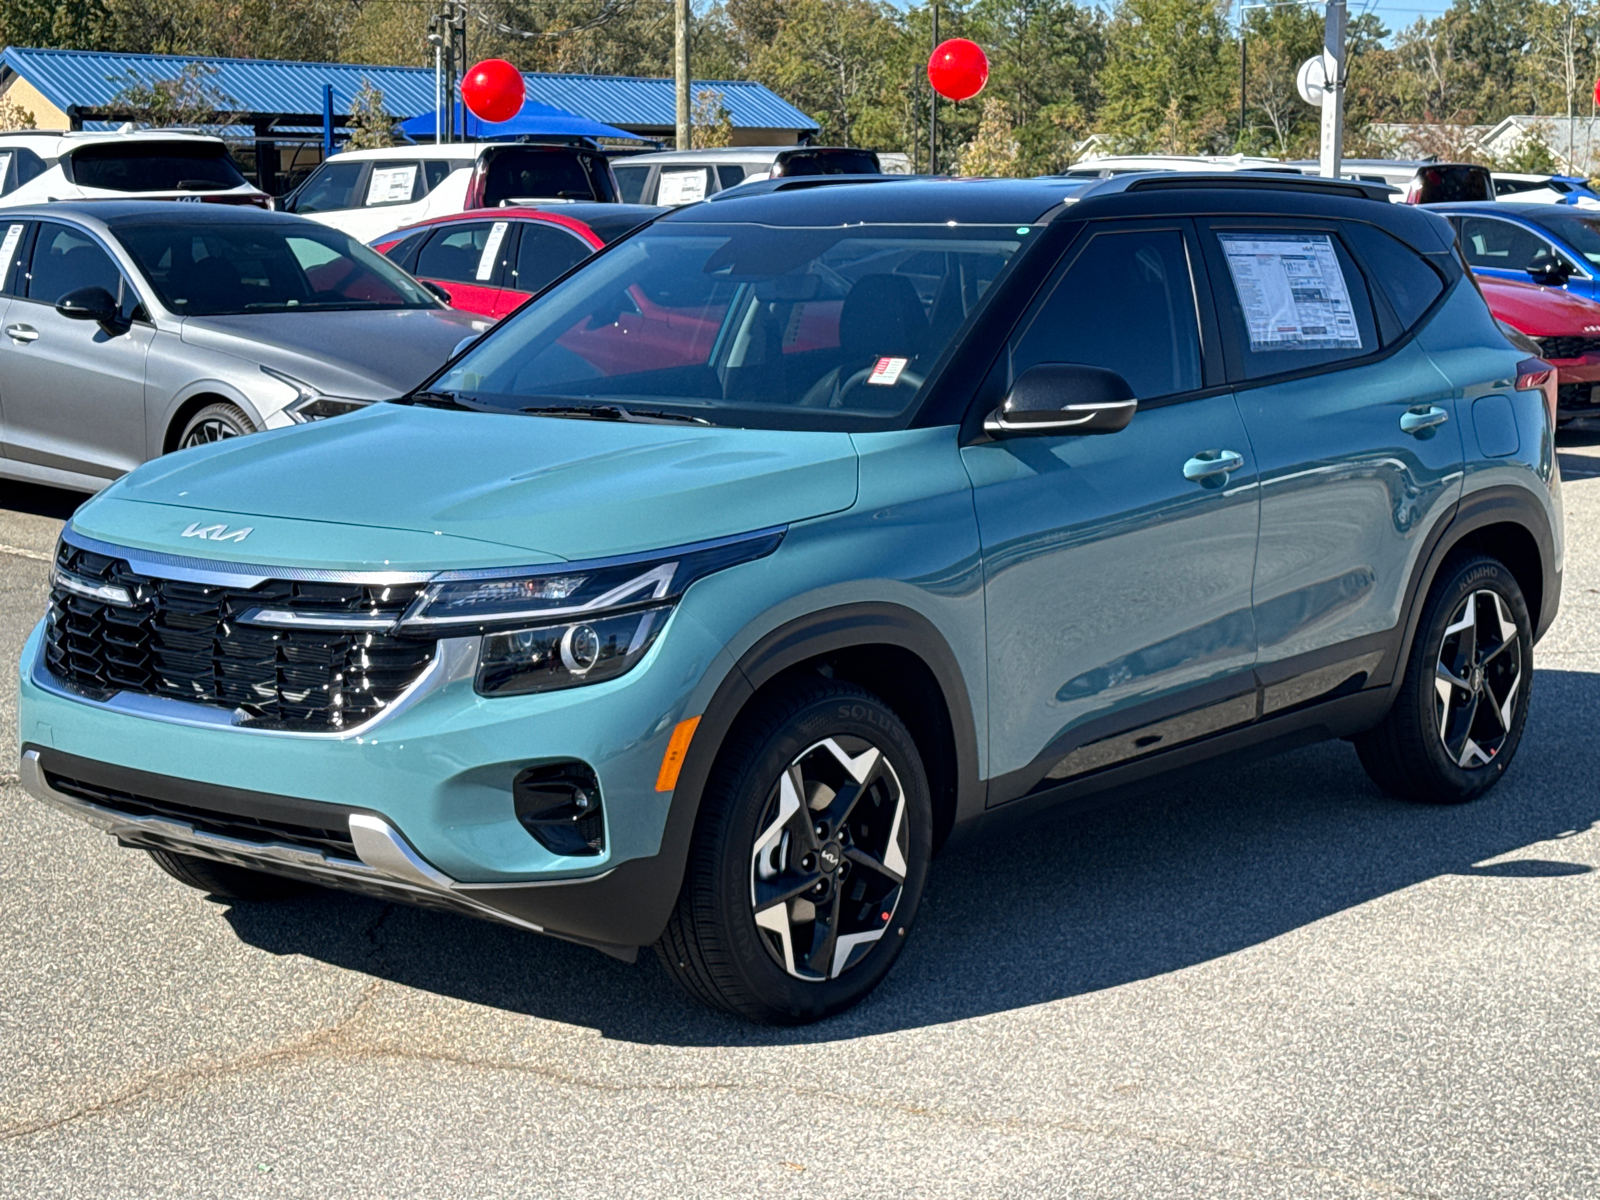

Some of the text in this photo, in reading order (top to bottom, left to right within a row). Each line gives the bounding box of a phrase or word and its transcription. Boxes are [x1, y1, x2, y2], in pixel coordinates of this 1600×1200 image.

[181, 521, 254, 543] KIA
[1458, 565, 1498, 592] KUMHO
[838, 704, 903, 742] SOLUS
